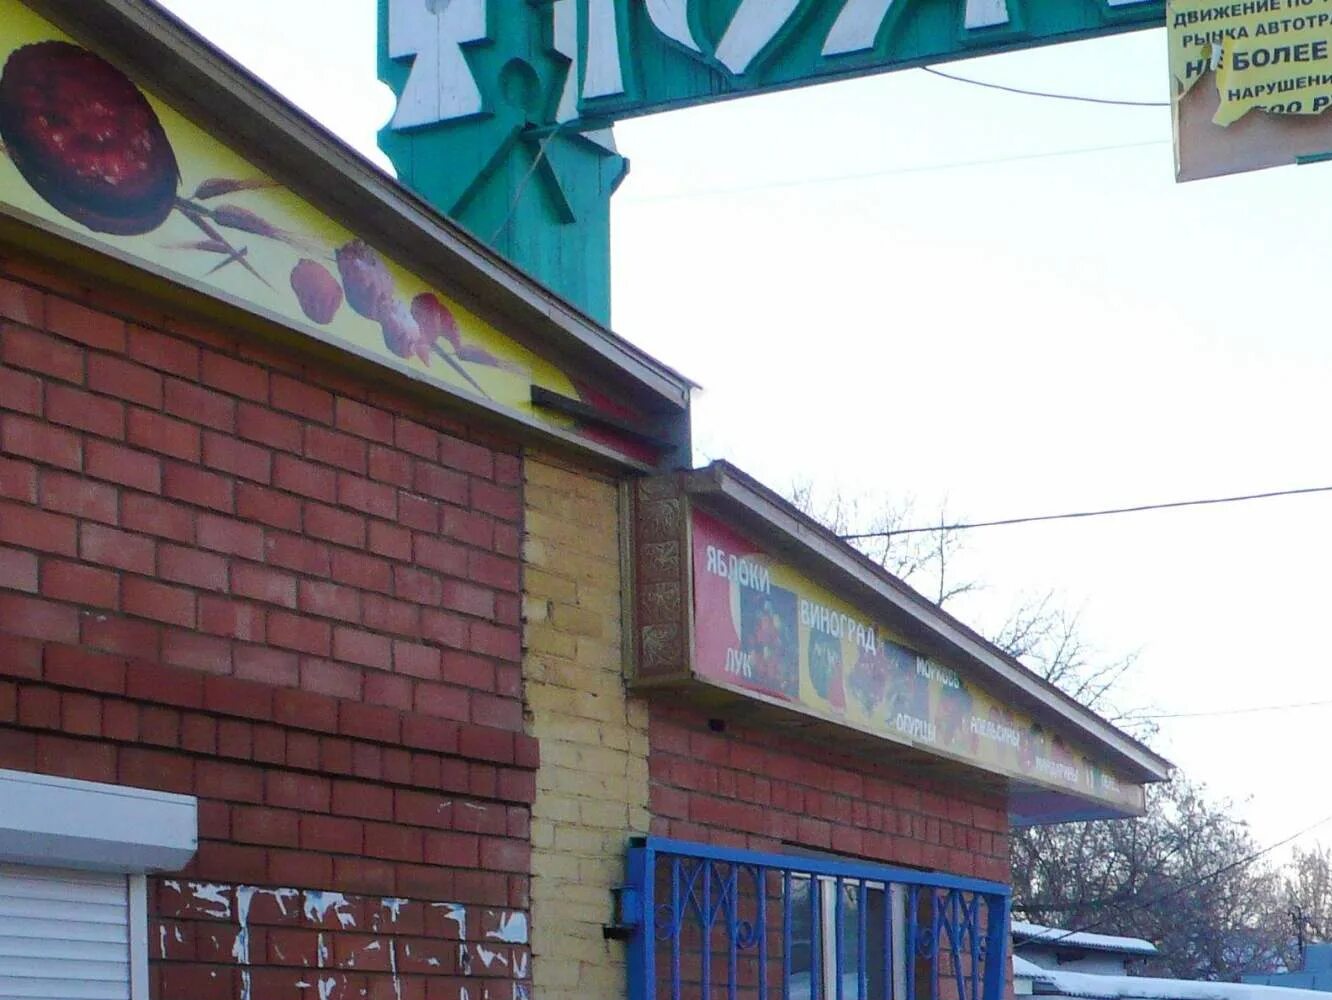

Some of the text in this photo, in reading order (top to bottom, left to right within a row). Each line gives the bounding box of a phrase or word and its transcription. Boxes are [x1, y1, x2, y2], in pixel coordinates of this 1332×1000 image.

[1173, 0, 1281, 29] ДВИЖЕНИЕ
[1182, 26, 1249, 48] РЫНКА
[1232, 40, 1328, 71] БОЛЕЕ
[706, 545, 771, 595] ЯБЛОКИ
[800, 599, 877, 657] ВИНОГРАД
[724, 646, 753, 679] ЛУК
